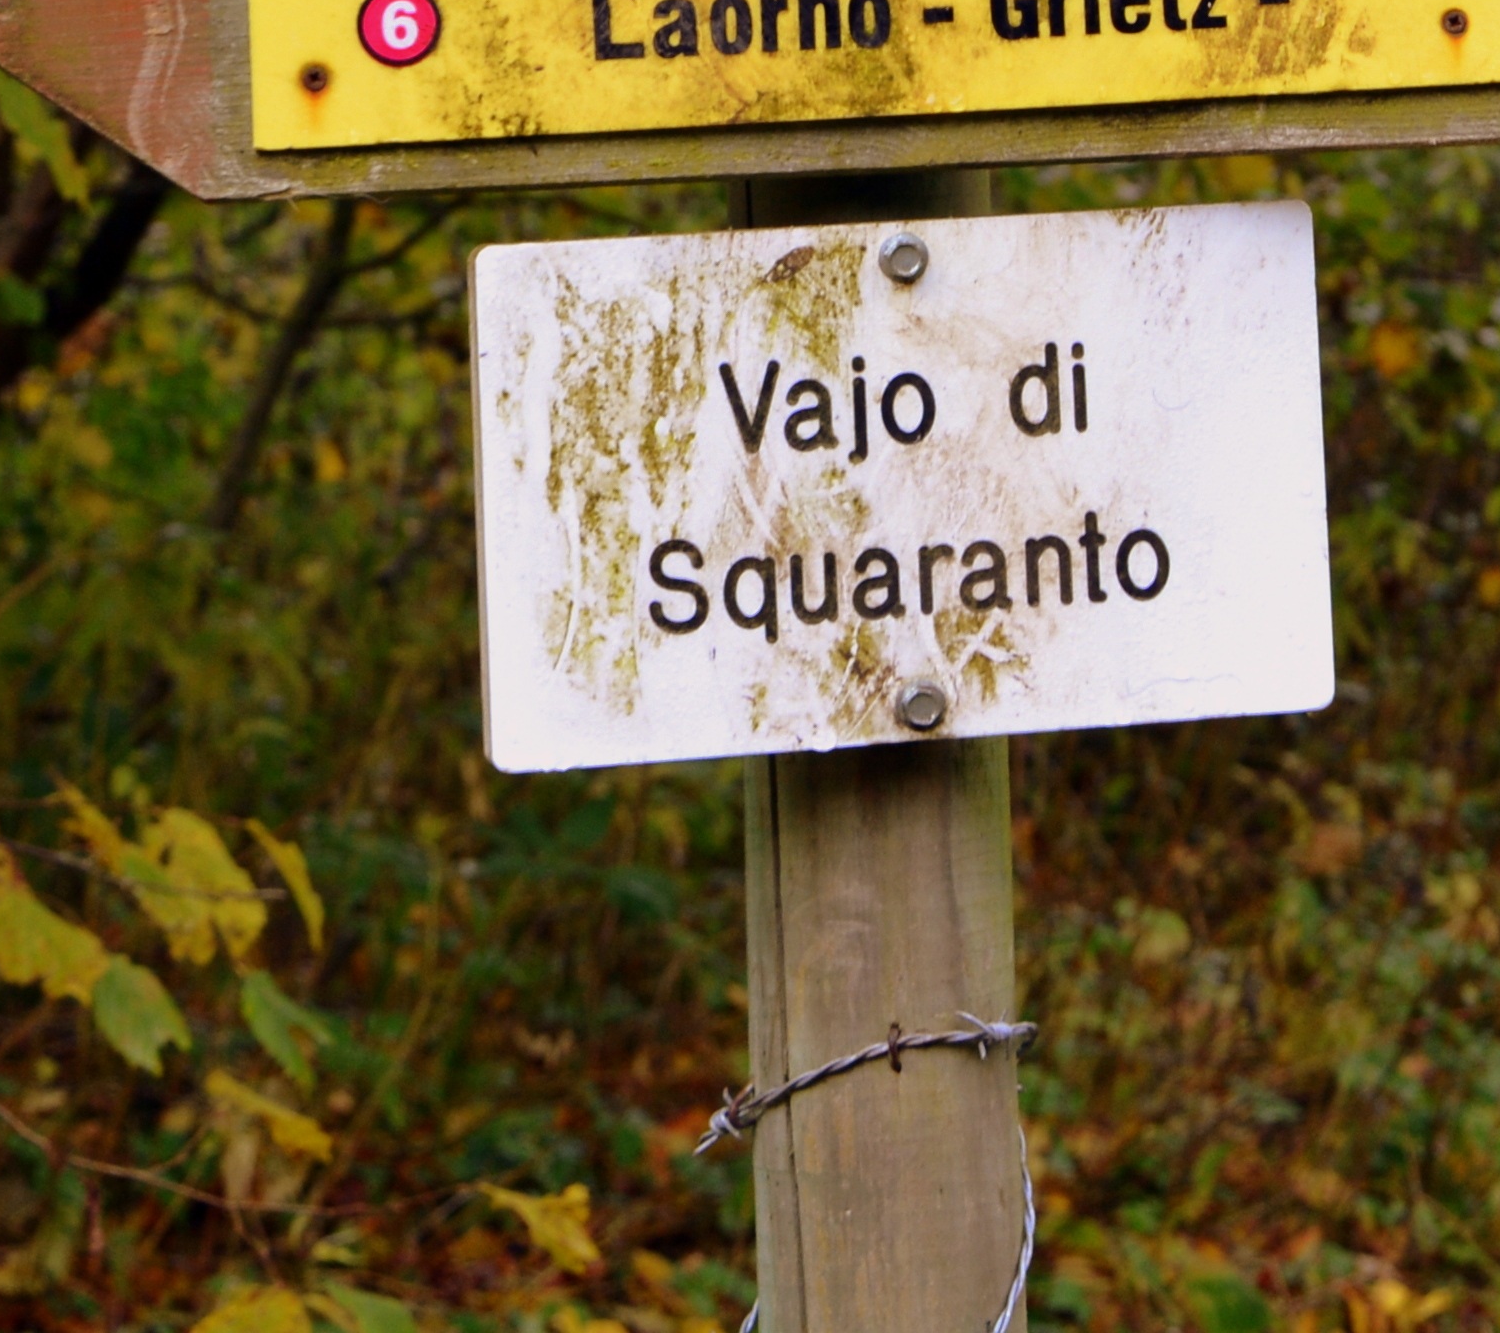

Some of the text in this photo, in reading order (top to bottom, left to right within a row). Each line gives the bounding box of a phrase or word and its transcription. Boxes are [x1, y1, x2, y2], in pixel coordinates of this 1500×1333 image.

[381, 0, 418, 48] 6
[719, 341, 1088, 464] Vajo di
[648, 510, 1171, 644] Squaranto
